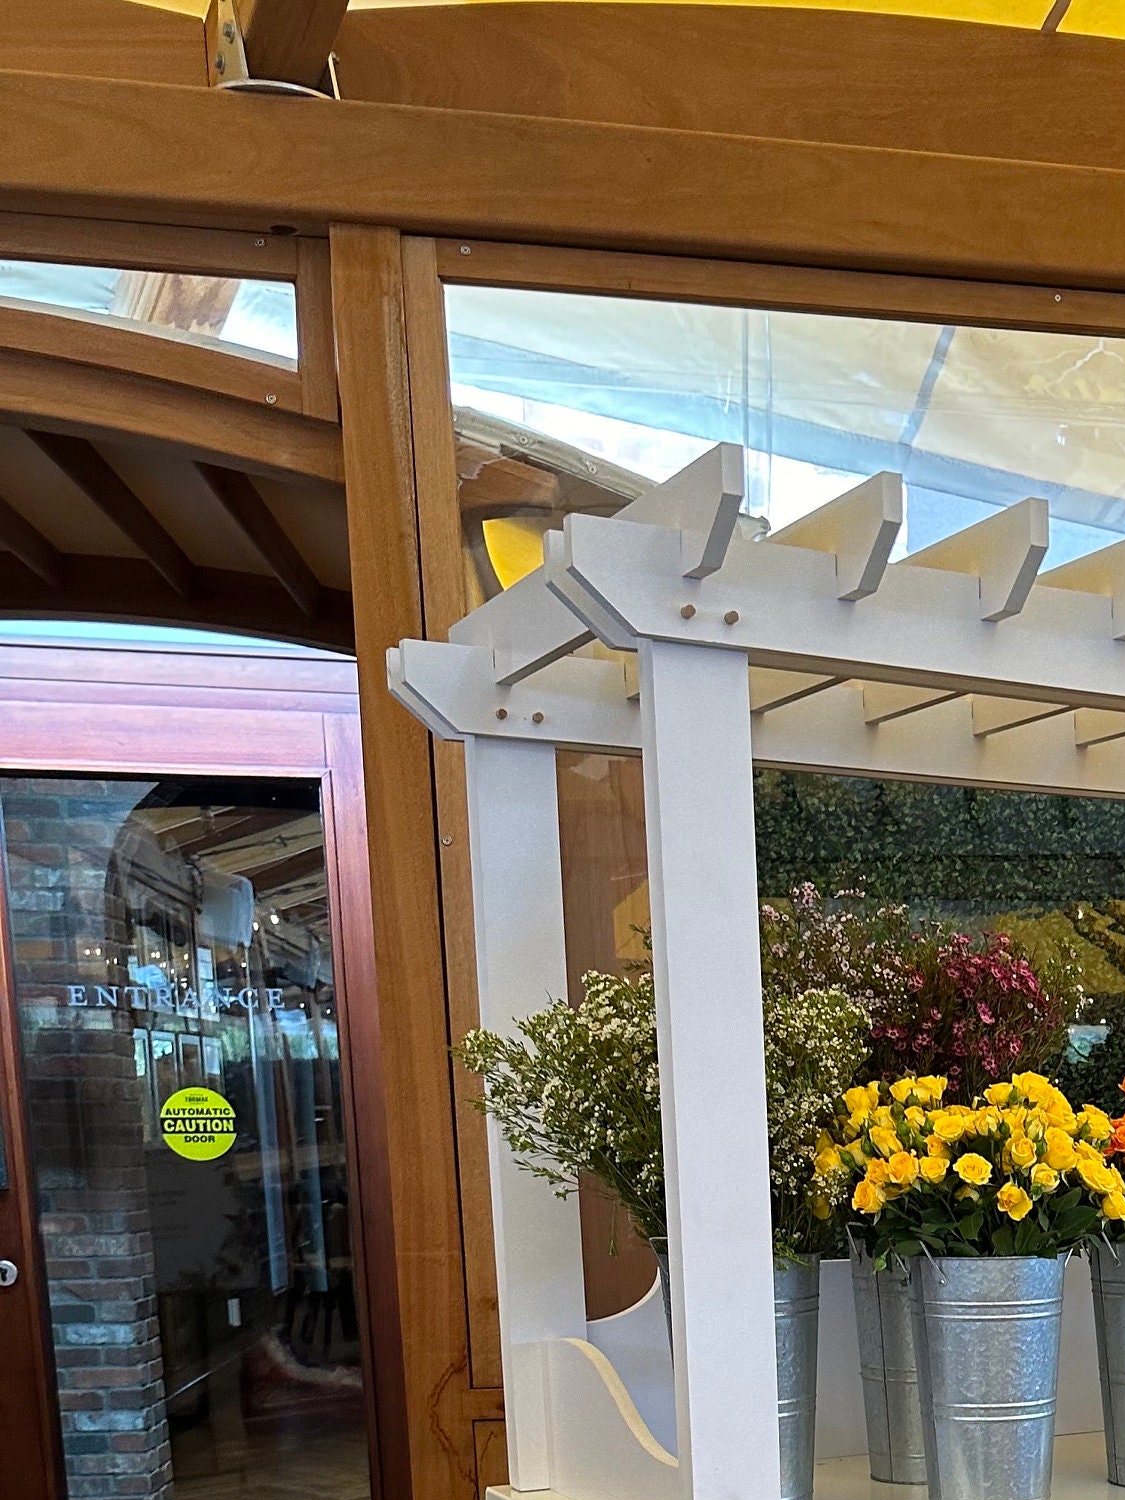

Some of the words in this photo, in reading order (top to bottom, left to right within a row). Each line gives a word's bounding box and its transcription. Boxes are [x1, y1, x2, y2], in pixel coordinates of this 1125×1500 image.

[67, 985, 285, 1009] ENTRANCE
[164, 1119, 234, 1131] CAUTION
[184, 1135, 216, 1143] DOOR
